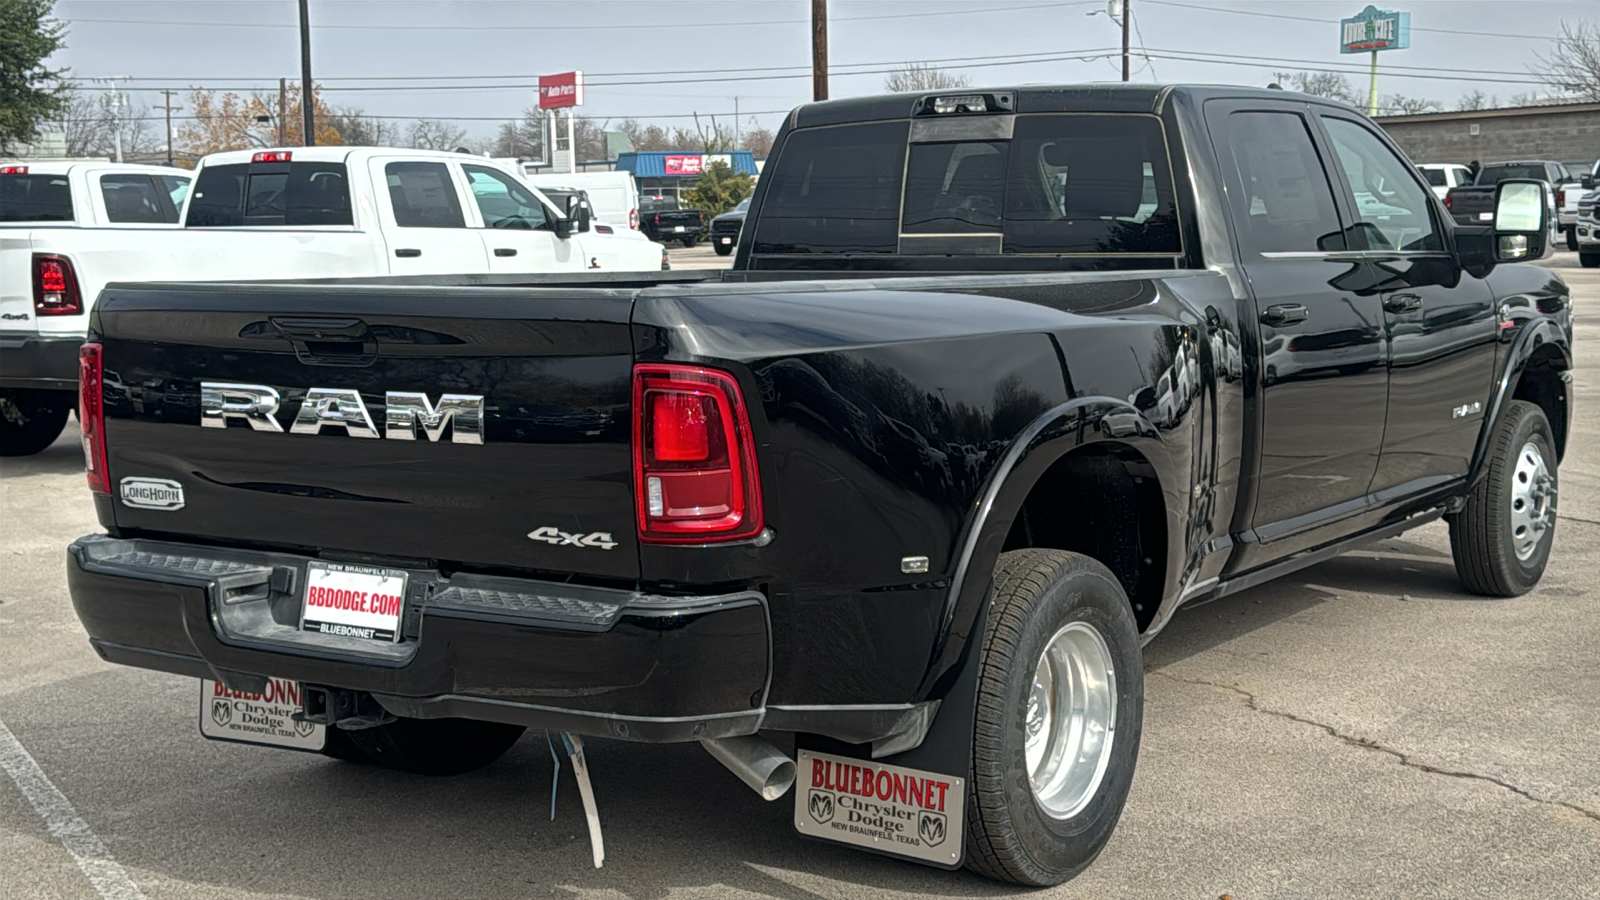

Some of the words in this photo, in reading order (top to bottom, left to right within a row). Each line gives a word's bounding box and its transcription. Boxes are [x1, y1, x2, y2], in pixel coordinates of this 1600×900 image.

[548, 86, 560, 97] Auto
[561, 85, 574, 95] Parts
[682, 158, 700, 166] Auto
[201, 381, 485, 446] RAM
[345, 565, 386, 576] BRAUNFELS
[308, 585, 402, 617] BBDODGE.COM
[320, 623, 376, 639] BLUEBONNET
[234, 701, 292, 717] Chrysler
[242, 712, 284, 729] Dodge
[229, 723, 242, 731] NEW
[278, 729, 296, 738] TEXAS
[811, 758, 950, 812] BLUEBONNET
[837, 795, 916, 821] Chrysler
[848, 810, 904, 833] Dodge
[831, 821, 848, 832] NEW
[896, 834, 920, 847] TEXAS
